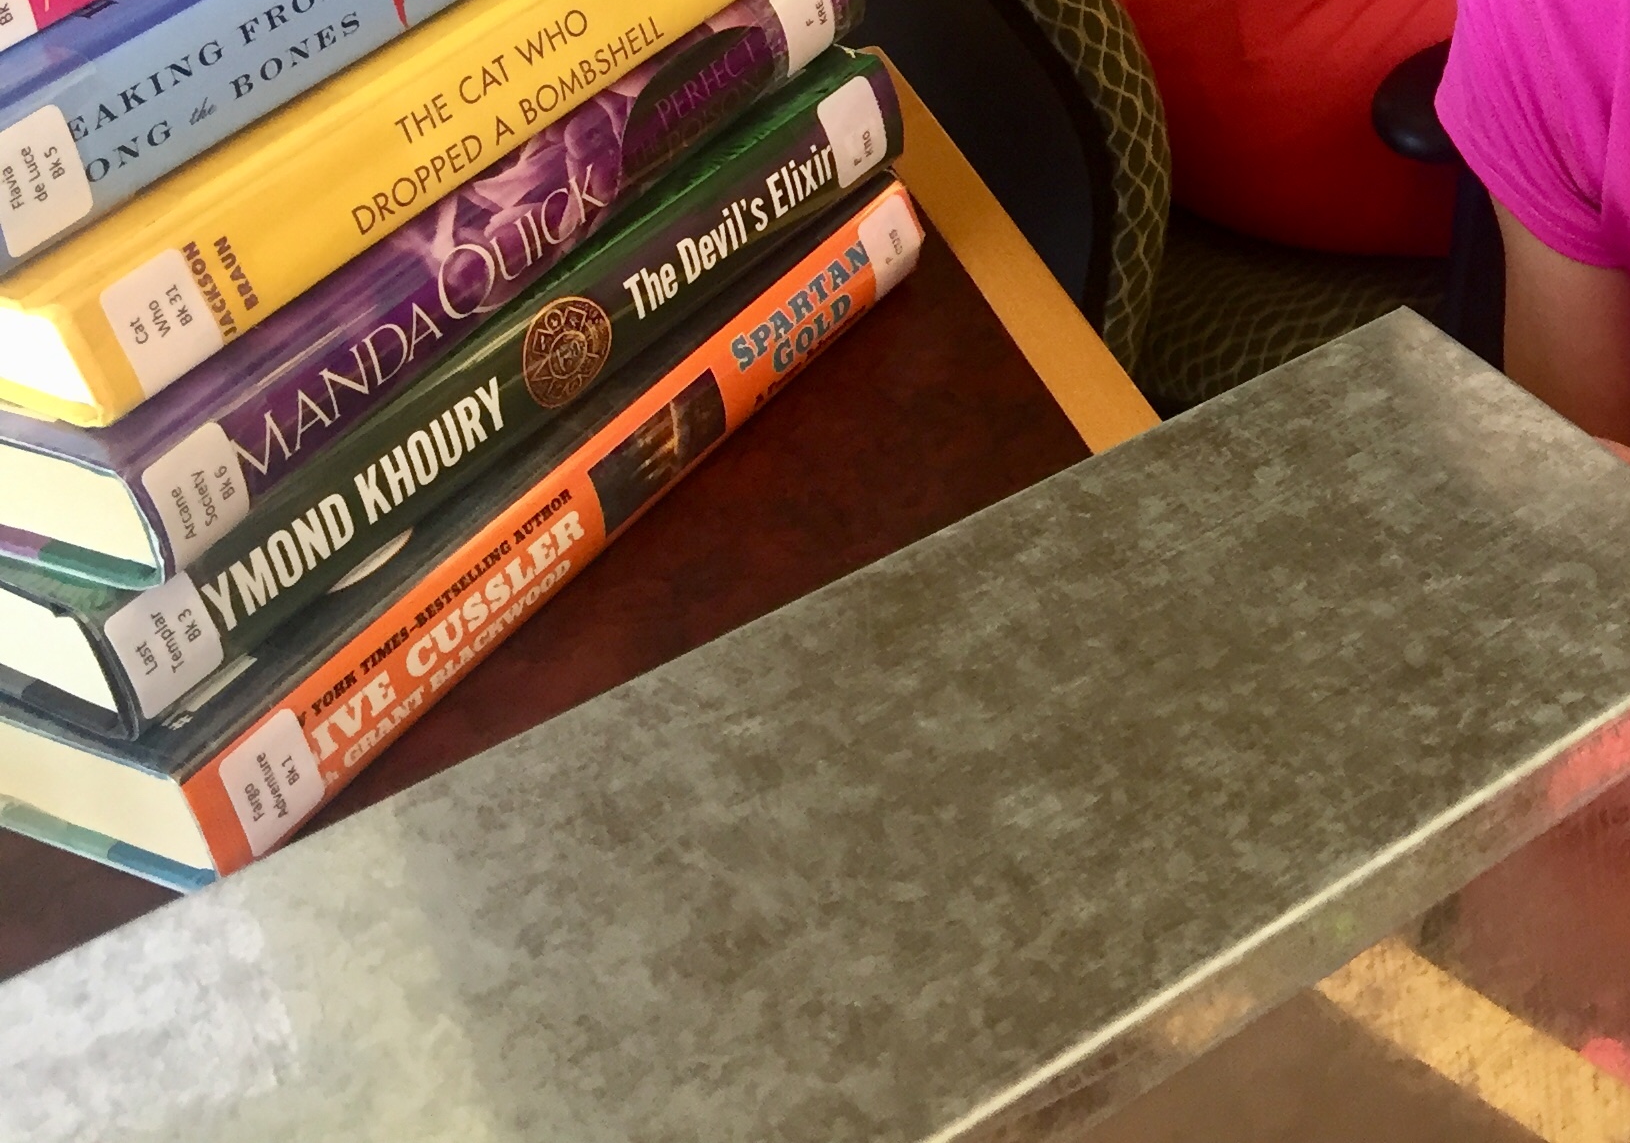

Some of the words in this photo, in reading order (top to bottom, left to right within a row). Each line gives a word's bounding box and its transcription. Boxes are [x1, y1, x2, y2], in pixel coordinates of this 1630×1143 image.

[816, 0, 828, 25] KRE
[67, 39, 225, 143] EAKING
[86, 120, 173, 182] ONG
[189, 97, 217, 126] the
[229, 11, 362, 101] BONES
[394, 93, 454, 145] THE
[458, 55, 511, 105] CAT
[514, 8, 589, 66] WHO
[655, 36, 757, 131] PERFECT
[44, 146, 57, 159] 5
[351, 133, 483, 236] DROPPED
[494, 117, 516, 146] A
[518, 15, 665, 127] BOMBSHELL
[2, 165, 25, 210] Flavia
[20, 146, 41, 183] Luce
[49, 159, 66, 180] Bk
[34, 182, 49, 203] de
[623, 258, 679, 320] The
[676, 195, 769, 285] Devil's
[765, 144, 834, 219] Elixir
[165, 284, 183, 306] 31
[182, 241, 238, 337] JACKSON
[213, 236, 260, 311] BRAUN
[129, 317, 149, 345] Cat
[148, 300, 171, 338] Who
[176, 305, 194, 327] Bk
[230, 303, 444, 476] MANDA
[438, 163, 609, 320] QUICK
[731, 240, 870, 373] SPARTAN
[772, 293, 852, 373] GOLD
[190, 469, 219, 527] Society
[214, 465, 228, 478] 6
[218, 477, 236, 500] Bk
[171, 486, 197, 540] Arcane
[201, 493, 355, 631] YMOND
[353, 376, 504, 525] KHOURY
[177, 608, 192, 623] 3
[311, 670, 358, 716] YORK
[513, 488, 573, 544] AUTHOR
[135, 640, 158, 676] Last
[150, 611, 185, 674] Templar
[185, 619, 202, 643] Bk
[311, 670, 396, 763] IVE
[404, 510, 585, 677] CUSSLER
[344, 685, 425, 768] GRANT
[429, 559, 571, 694] BLACKWOOD
[256, 752, 289, 819] Adventure
[281, 755, 291, 768] 1
[286, 767, 300, 786] Bk
[244, 783, 264, 822] Fargo
